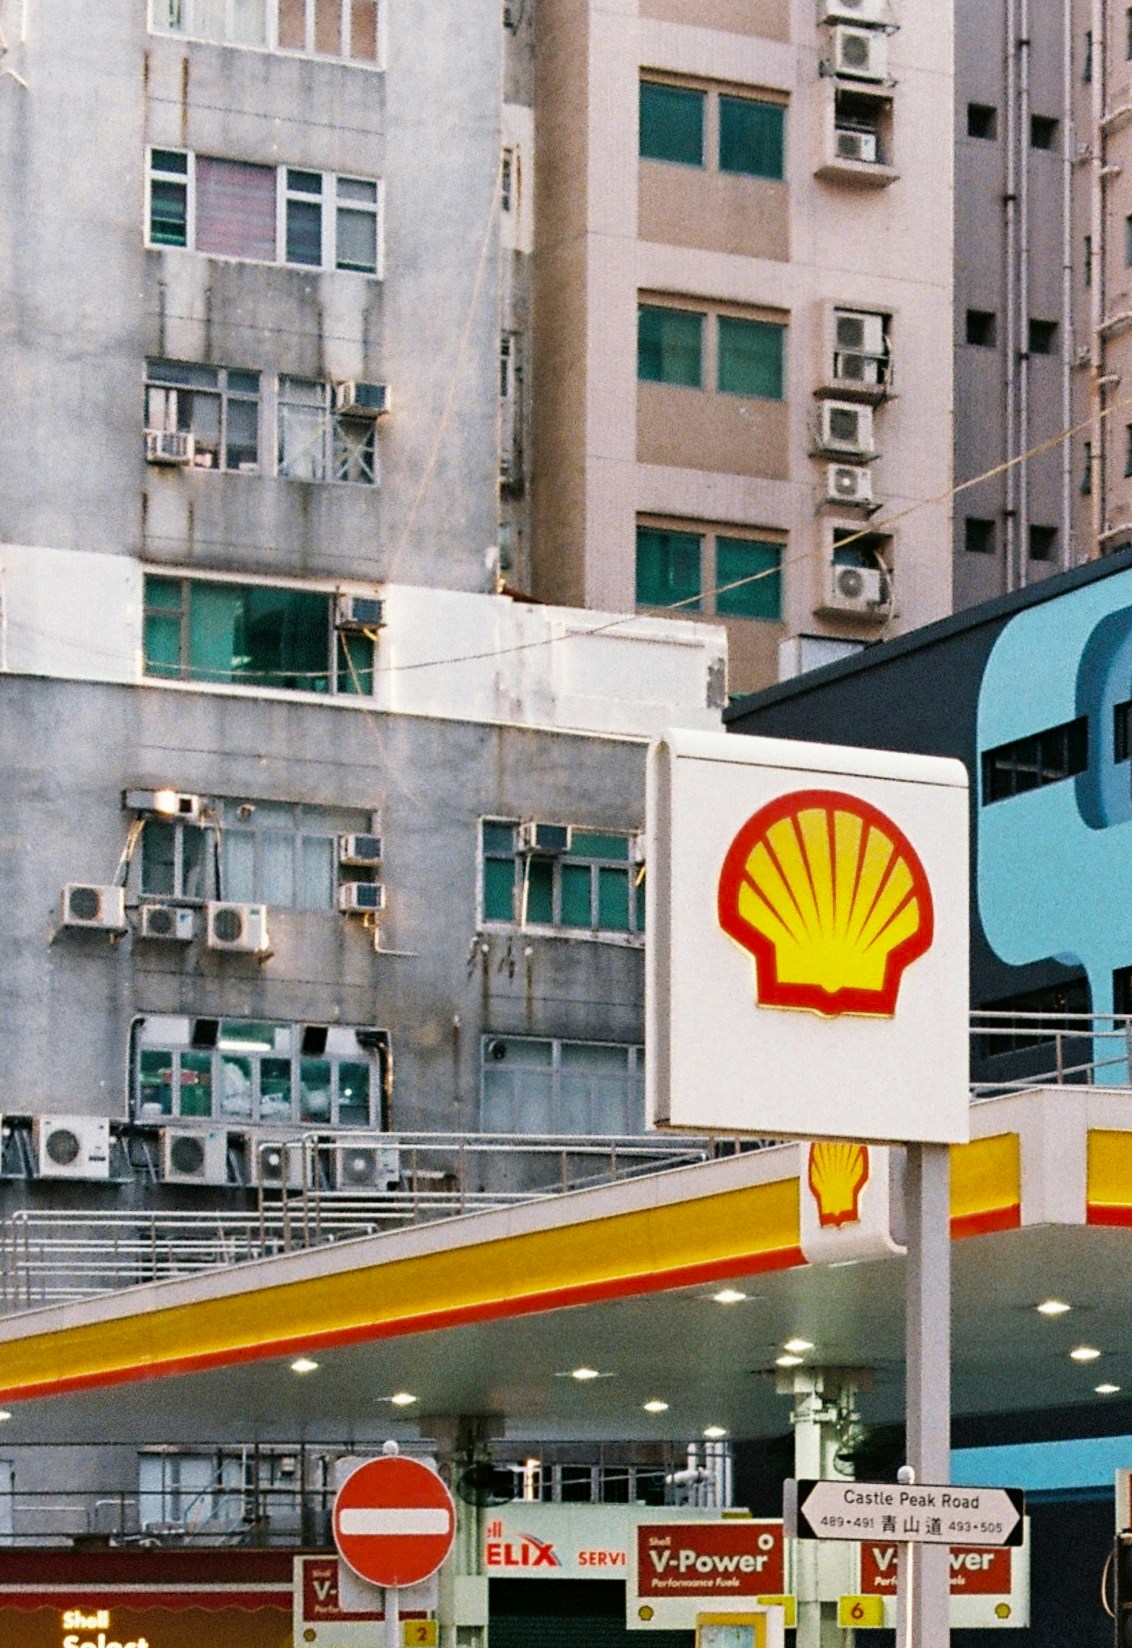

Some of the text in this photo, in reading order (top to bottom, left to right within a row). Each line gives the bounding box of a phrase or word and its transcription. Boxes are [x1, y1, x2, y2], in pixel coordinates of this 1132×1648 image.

[843, 1489, 980, 1510] Castle Peak Road
[881, 1514, 943, 1536] 青山道
[649, 1537, 671, 1547] Shell
[487, 1542, 627, 1567] ELIX SERVI
[649, 1550, 768, 1573] V-Power
[872, 1547, 995, 1571] V-wer
[652, 1577, 741, 1589] Performance Fuels
[63, 1610, 110, 1629] Shell
[851, 1603, 864, 1620] 6
[417, 1627, 428, 1642] 2
